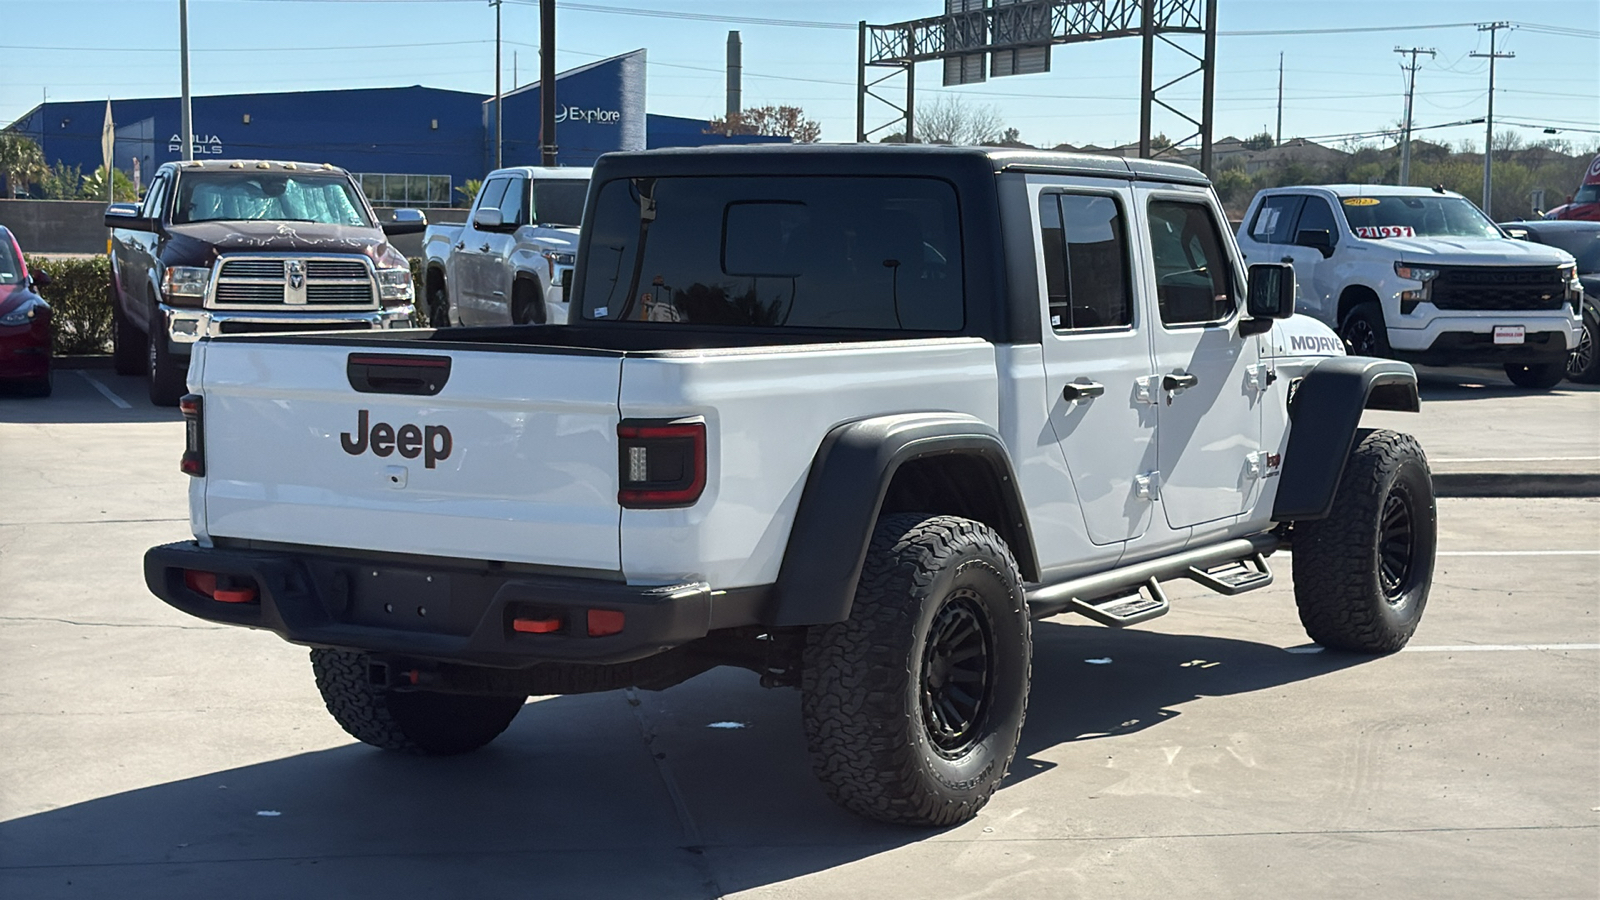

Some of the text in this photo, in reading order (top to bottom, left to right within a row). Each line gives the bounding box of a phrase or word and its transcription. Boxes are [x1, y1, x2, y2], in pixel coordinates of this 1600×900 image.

[569, 106, 620, 124] Explore
[170, 134, 222, 144] AUA
[168, 144, 223, 154] POLS
[1358, 226, 1413, 238] 21997
[1290, 335, 1344, 353] MOJAVE
[340, 409, 453, 469] Jeep
